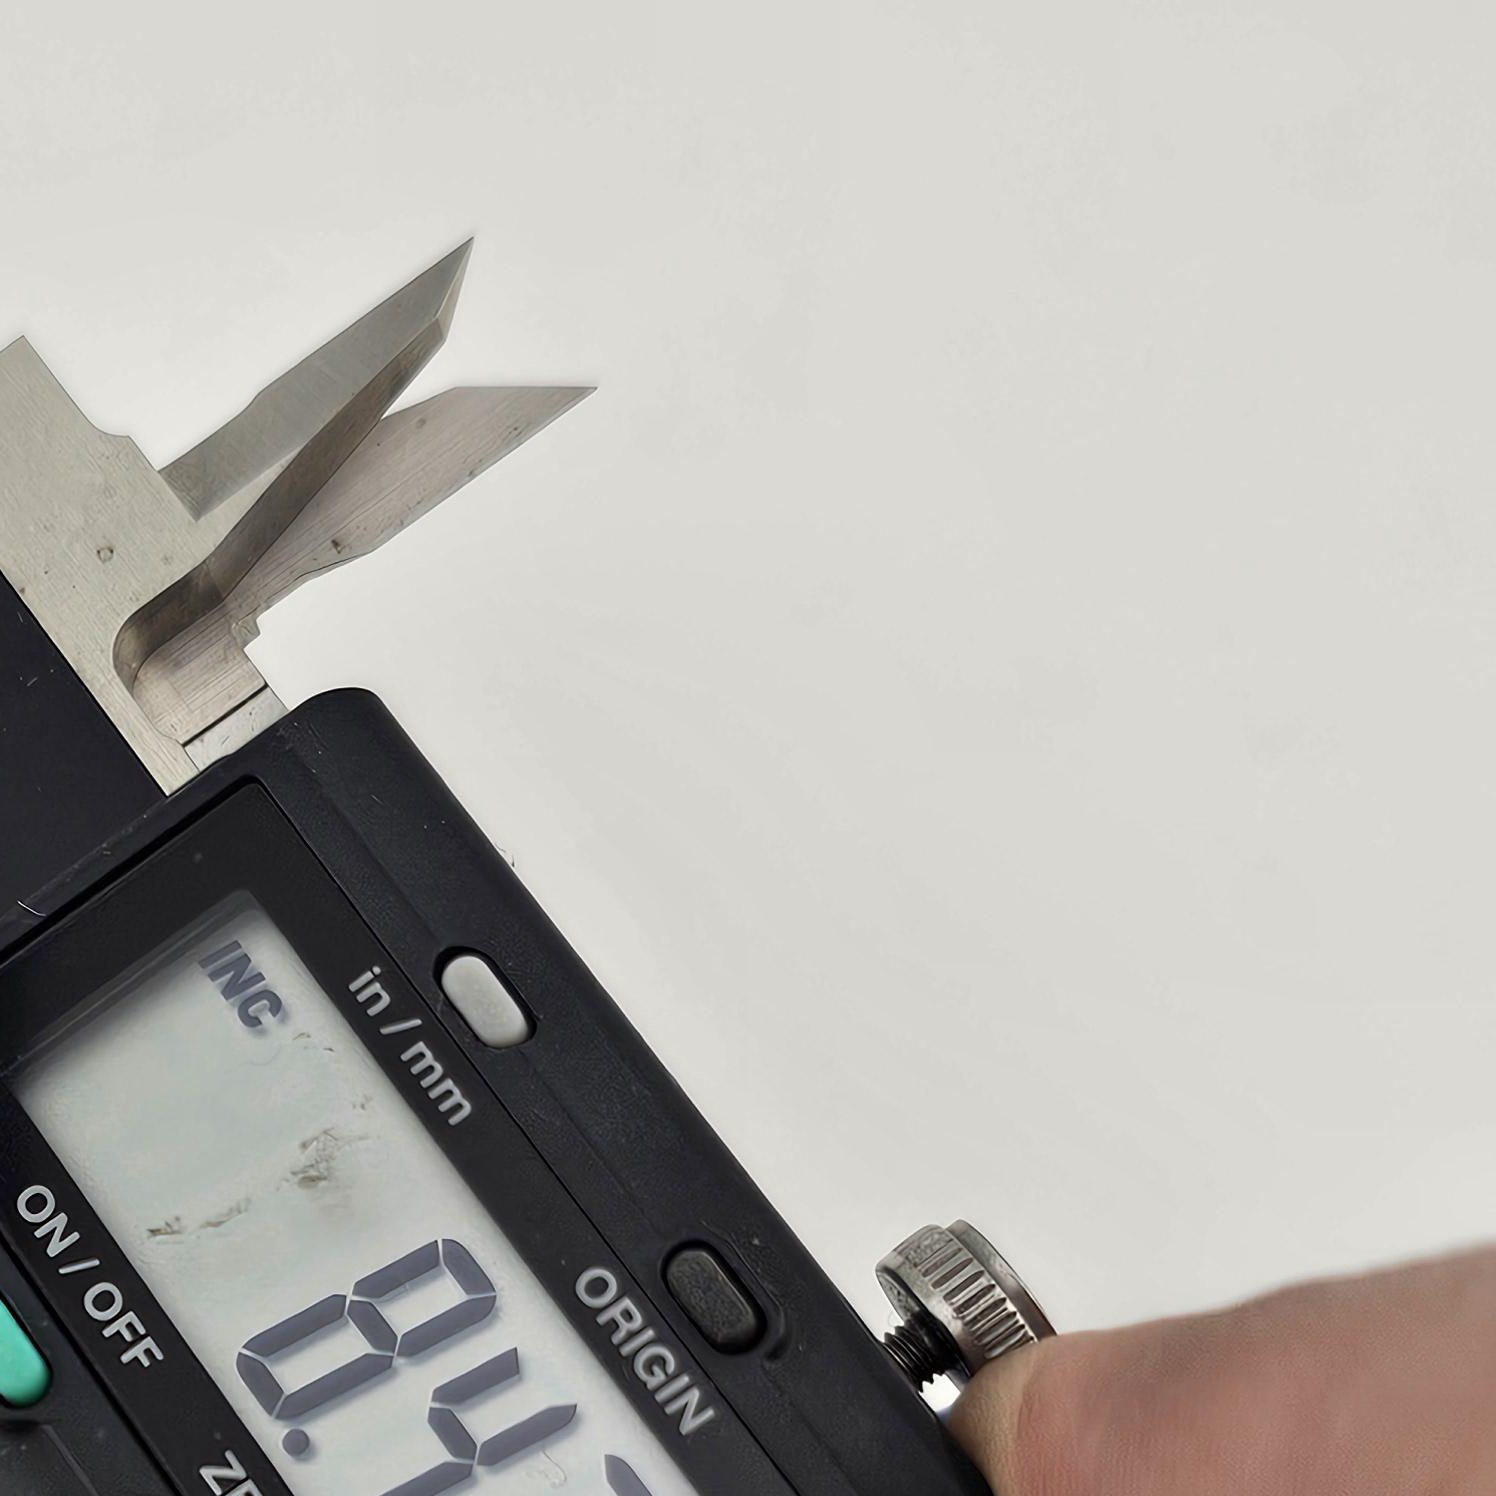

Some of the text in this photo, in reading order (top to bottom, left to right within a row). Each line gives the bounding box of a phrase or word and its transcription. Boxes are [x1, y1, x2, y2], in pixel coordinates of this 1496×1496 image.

[197, 939, 286, 1031] INC
[347, 965, 391, 1017] in
[399, 1041, 473, 1127] mm
[15, 1184, 81, 1258] ON
[82, 1281, 165, 1369] OFF
[573, 1267, 717, 1437] ORIGIN
